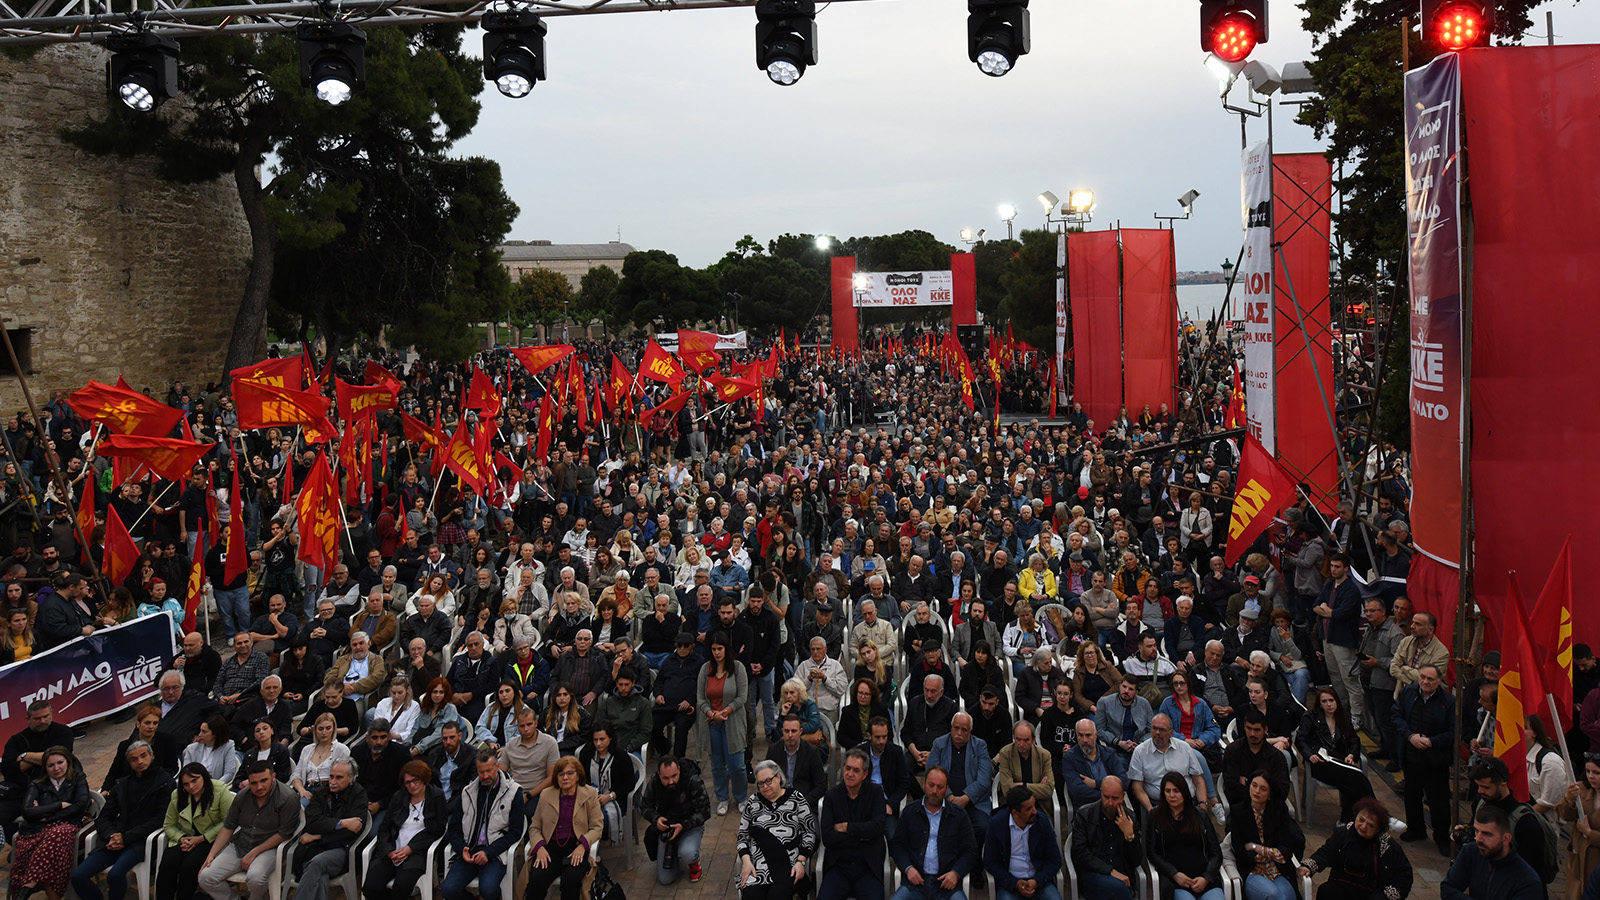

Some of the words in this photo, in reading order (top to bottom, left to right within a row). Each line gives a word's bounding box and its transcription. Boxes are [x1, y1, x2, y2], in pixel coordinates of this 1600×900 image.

[893, 296, 918, 305] ΜΑΣ
[930, 291, 951, 301] ΚΚΕ
[649, 357, 676, 379] ΚΚΕ
[350, 393, 393, 414] ΚΚΕ
[67, 661, 113, 692] ΛΑΟ
